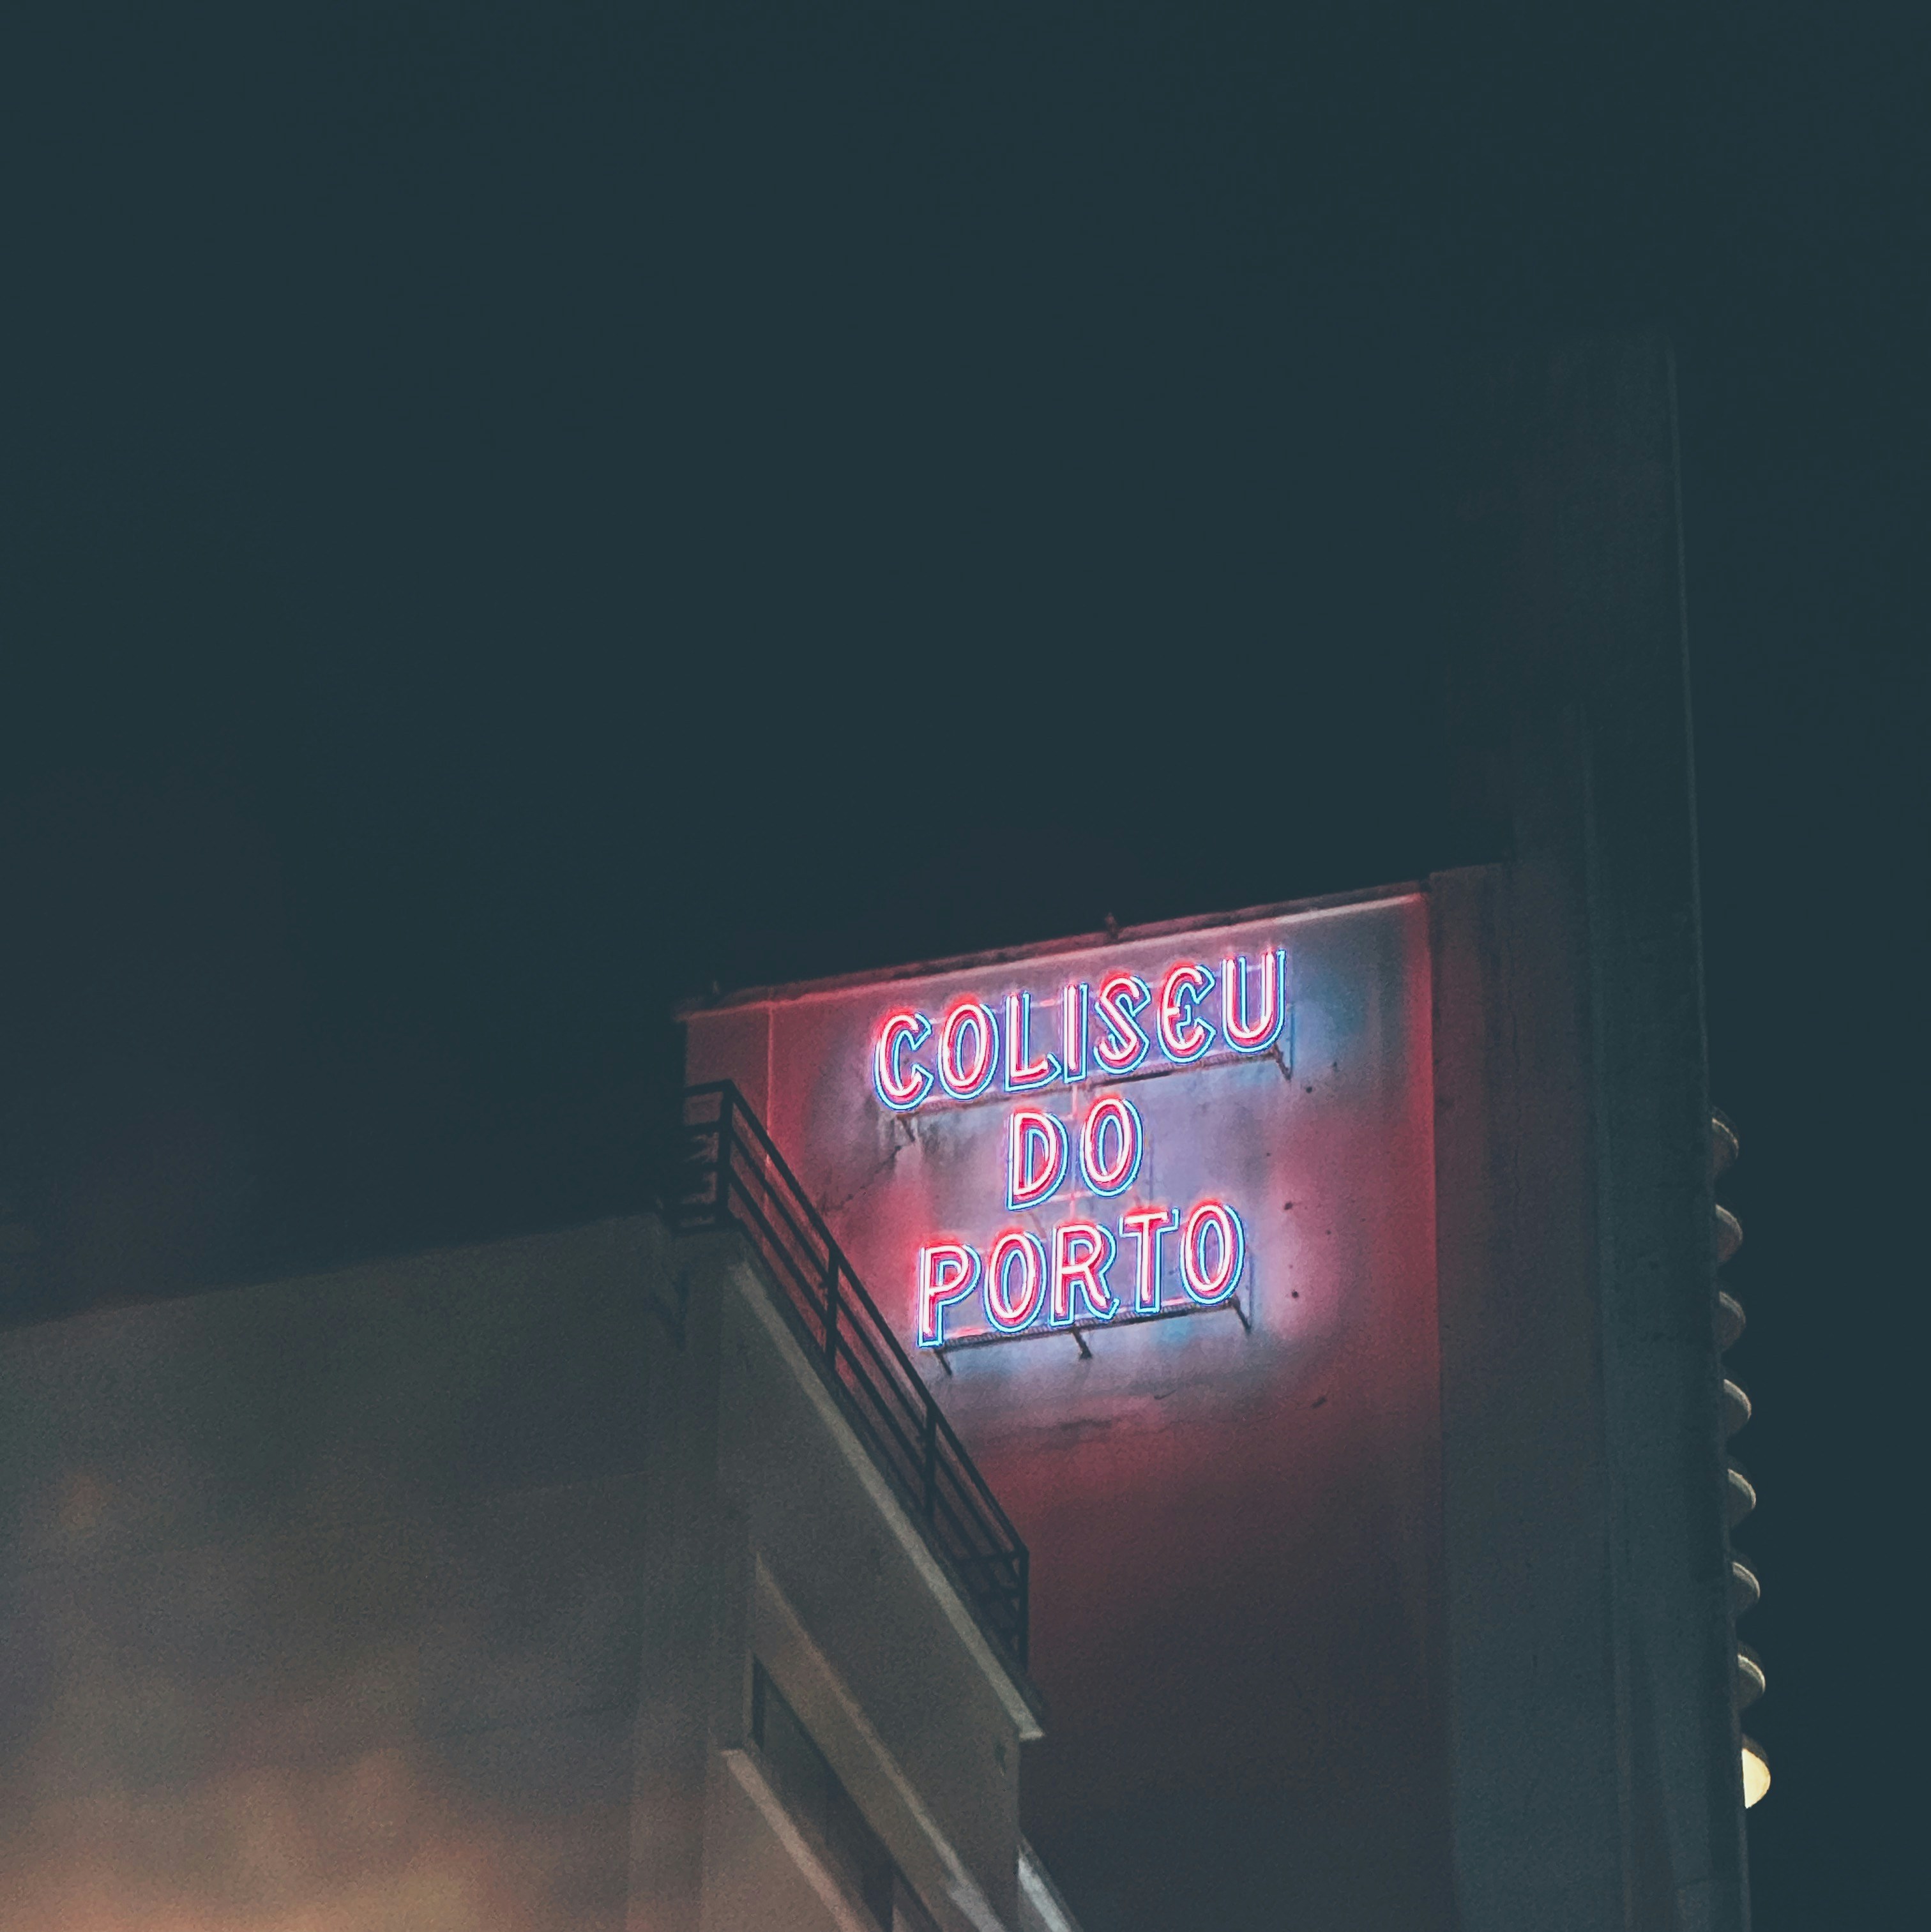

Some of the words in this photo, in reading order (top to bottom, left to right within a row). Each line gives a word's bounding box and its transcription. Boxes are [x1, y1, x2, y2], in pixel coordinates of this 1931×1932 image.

[873, 948, 1286, 1111] COLISEU
[1006, 1097, 1144, 1211] DO
[916, 1202, 1245, 1349] PORTO
